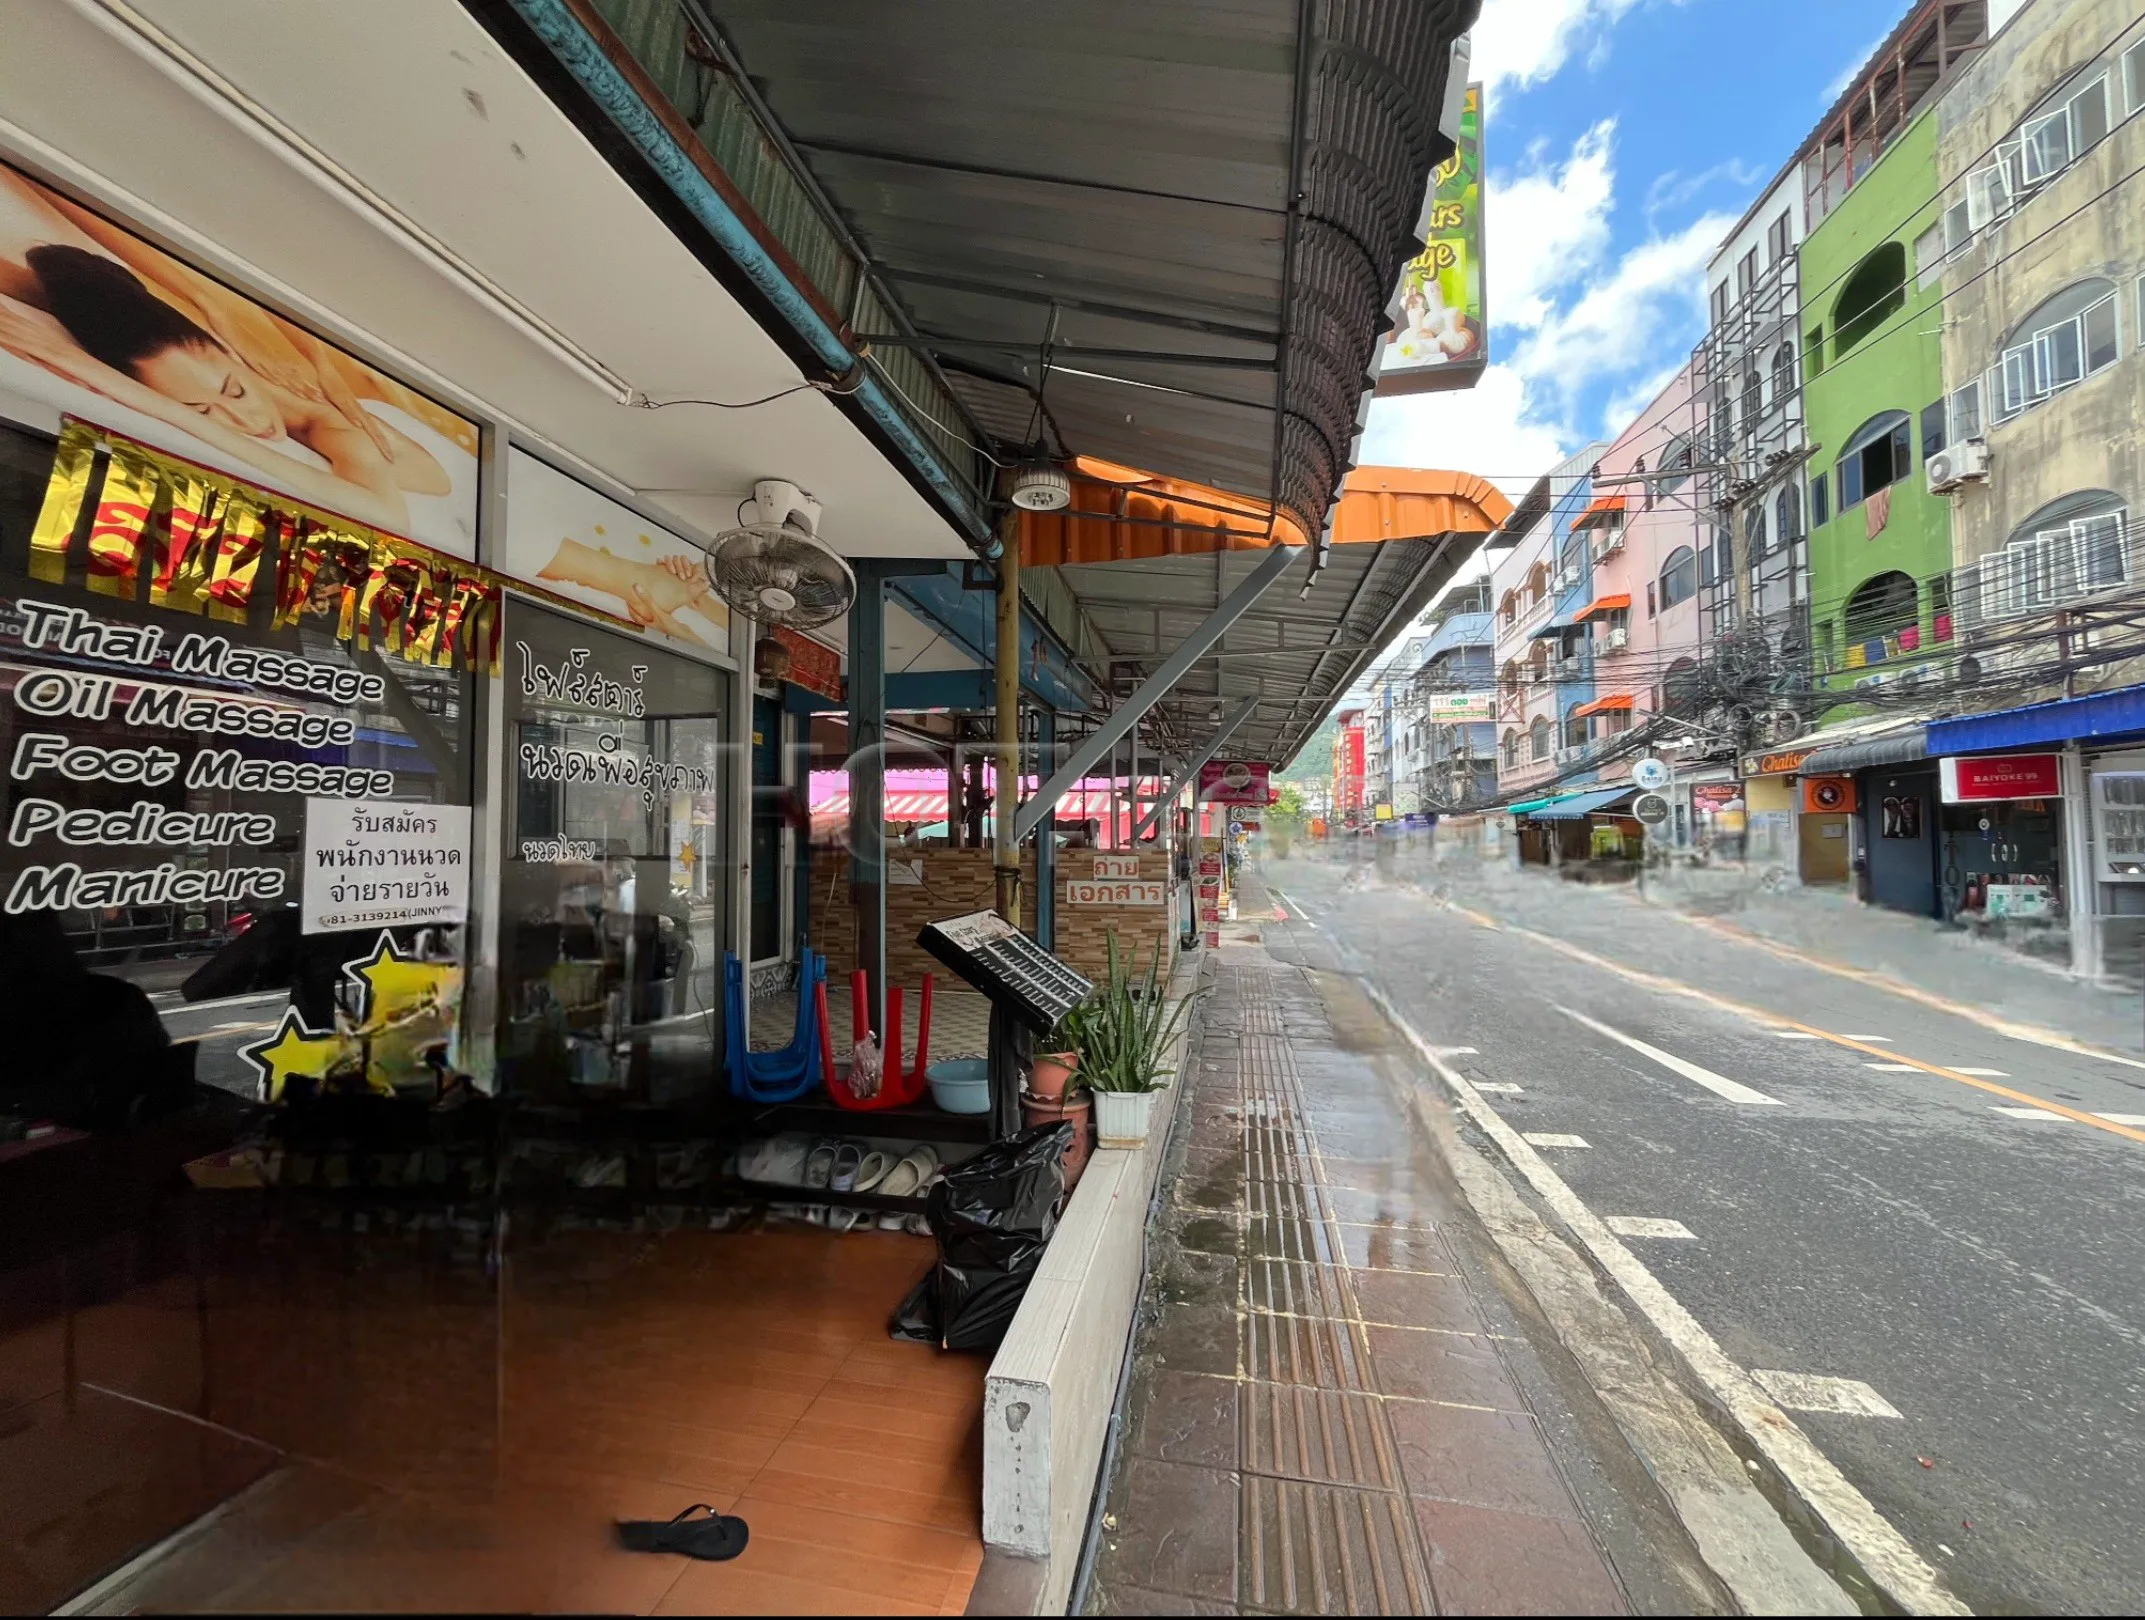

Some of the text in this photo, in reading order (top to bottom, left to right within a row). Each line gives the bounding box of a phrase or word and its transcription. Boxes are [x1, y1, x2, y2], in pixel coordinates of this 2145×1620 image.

[16, 598, 164, 666] Thai
[171, 634, 386, 702] Massage
[13, 672, 356, 749] Oil Massage
[10, 733, 394, 799] Foot Massage
[8, 798, 277, 848] Pedicure
[352, 807, 437, 833] รับสมัคร
[316, 839, 461, 867] พนักงานนวด
[1095, 857, 1138, 876] ถ่าย
[5, 862, 286, 915] Manicure
[330, 872, 449, 902] จ่ายรายวัน
[1070, 884, 1160, 902] เอกสาร
